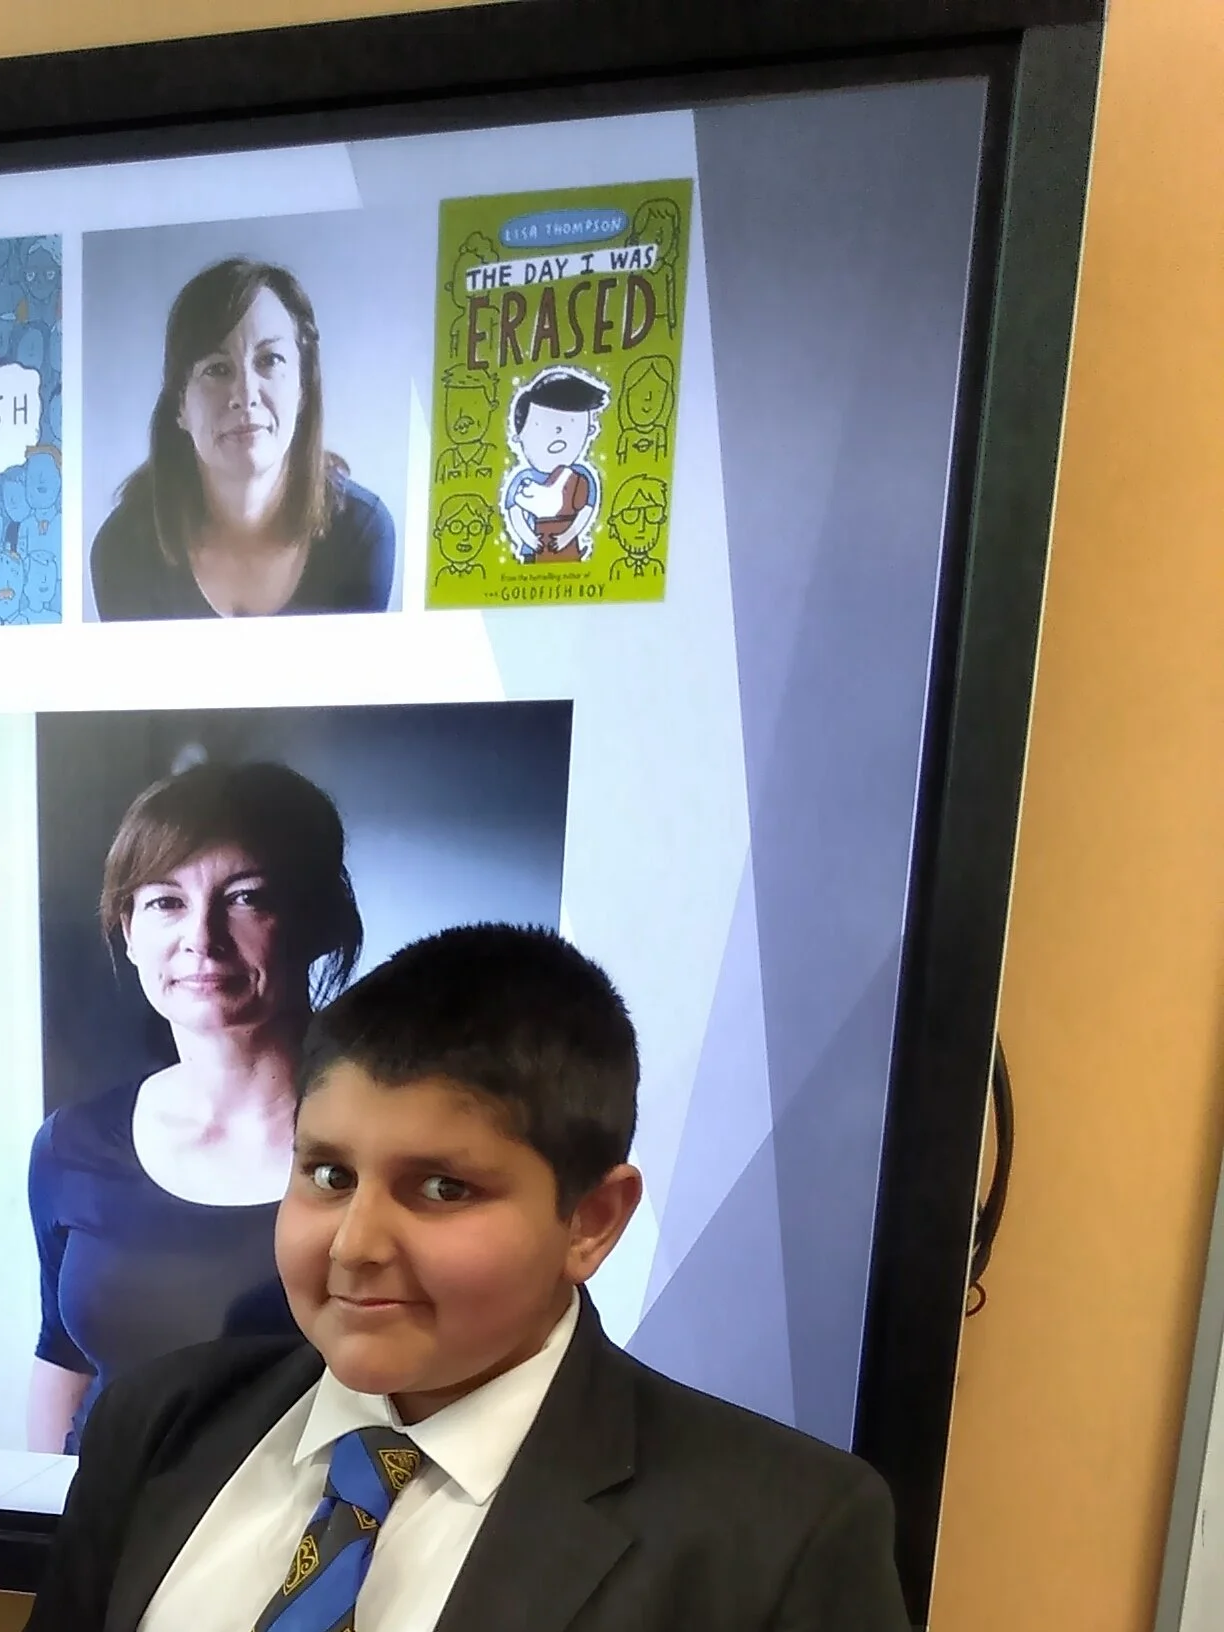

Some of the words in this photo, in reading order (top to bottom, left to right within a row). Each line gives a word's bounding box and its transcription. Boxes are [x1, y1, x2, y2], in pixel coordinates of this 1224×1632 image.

[505, 226, 538, 242] LISA
[546, 217, 622, 236] THOMPSON
[466, 265, 513, 290] THE
[524, 257, 569, 284] DAY
[580, 254, 594, 275] I
[610, 246, 654, 271] WAS
[467, 274, 656, 371] ERASED
[501, 584, 573, 601] GOLDFISH
[579, 584, 606, 598] BOY
